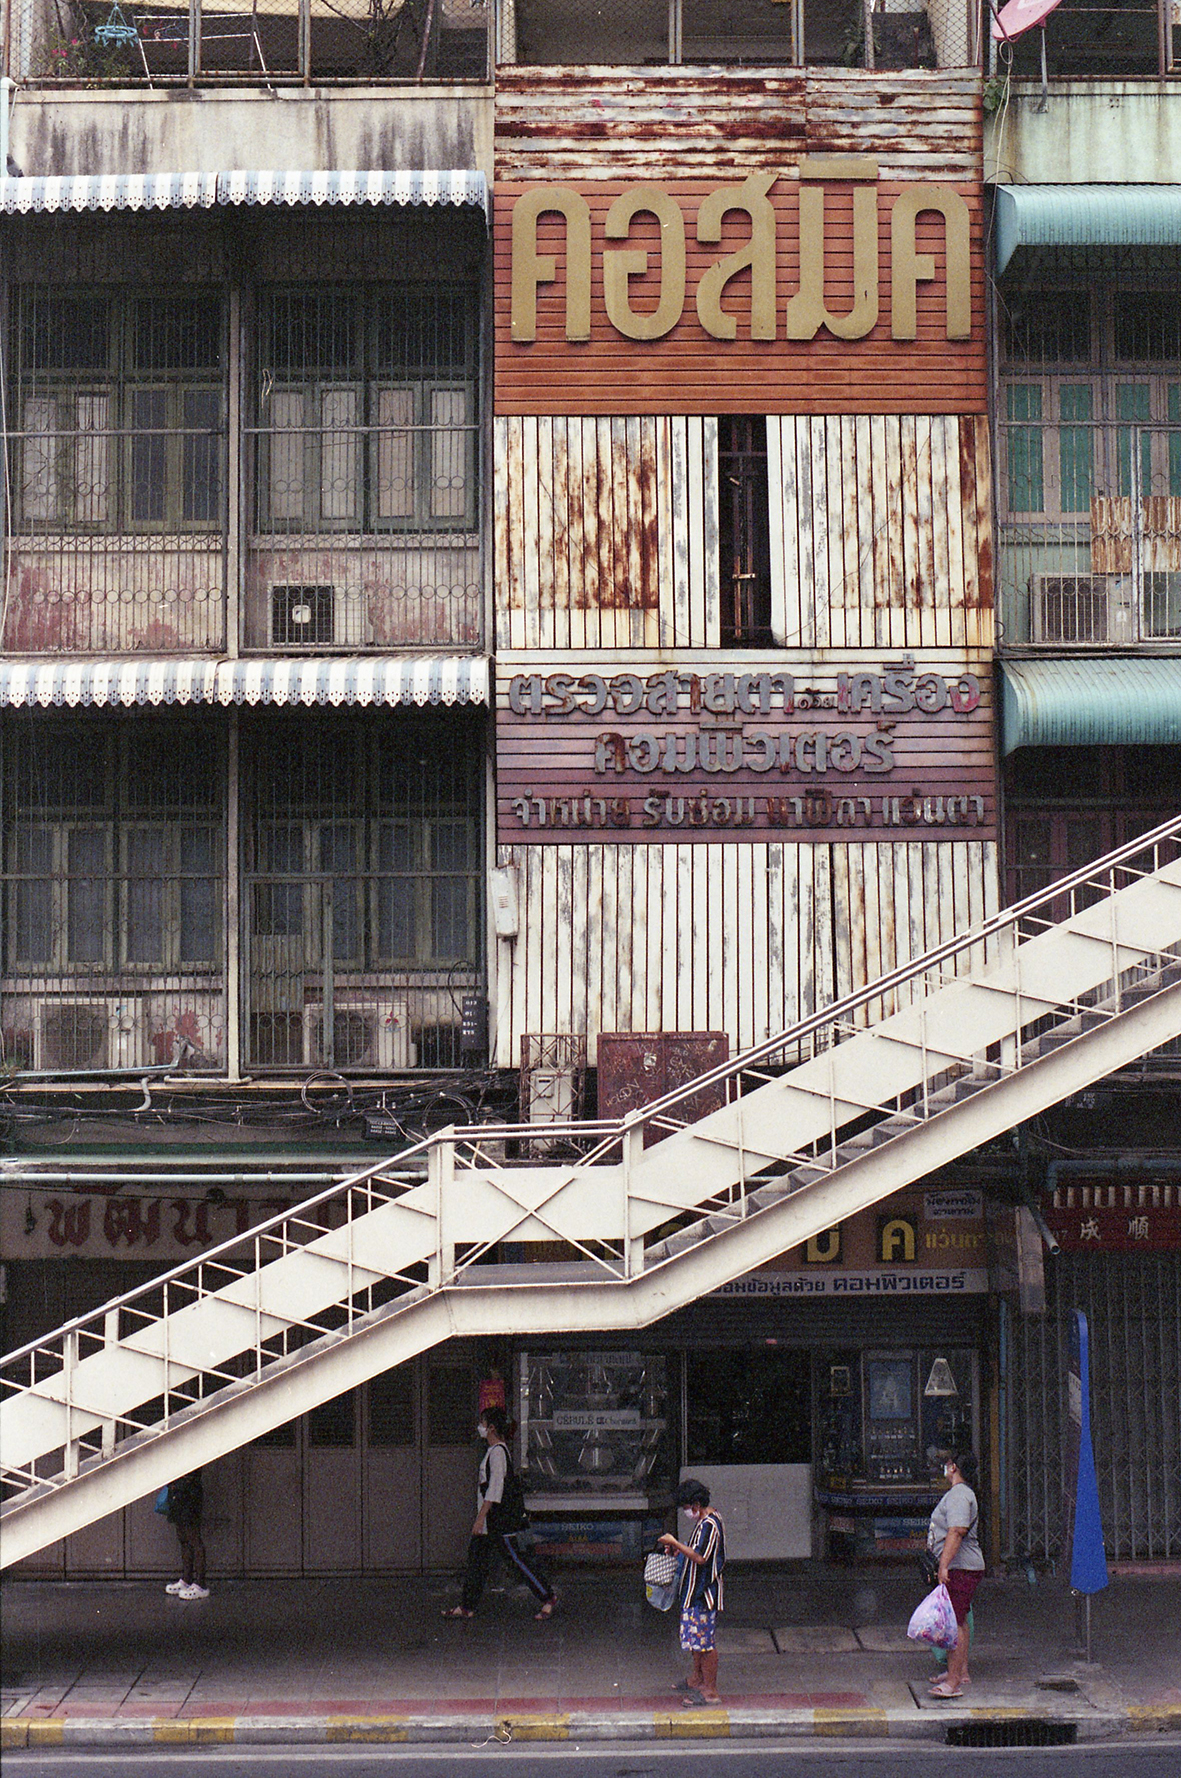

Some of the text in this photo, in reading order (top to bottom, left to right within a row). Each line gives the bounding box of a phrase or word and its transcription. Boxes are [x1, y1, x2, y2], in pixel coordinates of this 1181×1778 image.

[509, 669, 795, 715] ตรวจสายตา
[837, 653, 982, 715] เครื่อง
[594, 720, 896, 774] คอมพิวเตอร์
[511, 787, 985, 826] จำหน่าย รับซ่อม นาฬิกา แว่นตา
[833, 1272, 966, 1293] คอมพิวเตอร์
[561, 1523, 594, 1531] SEIKO
